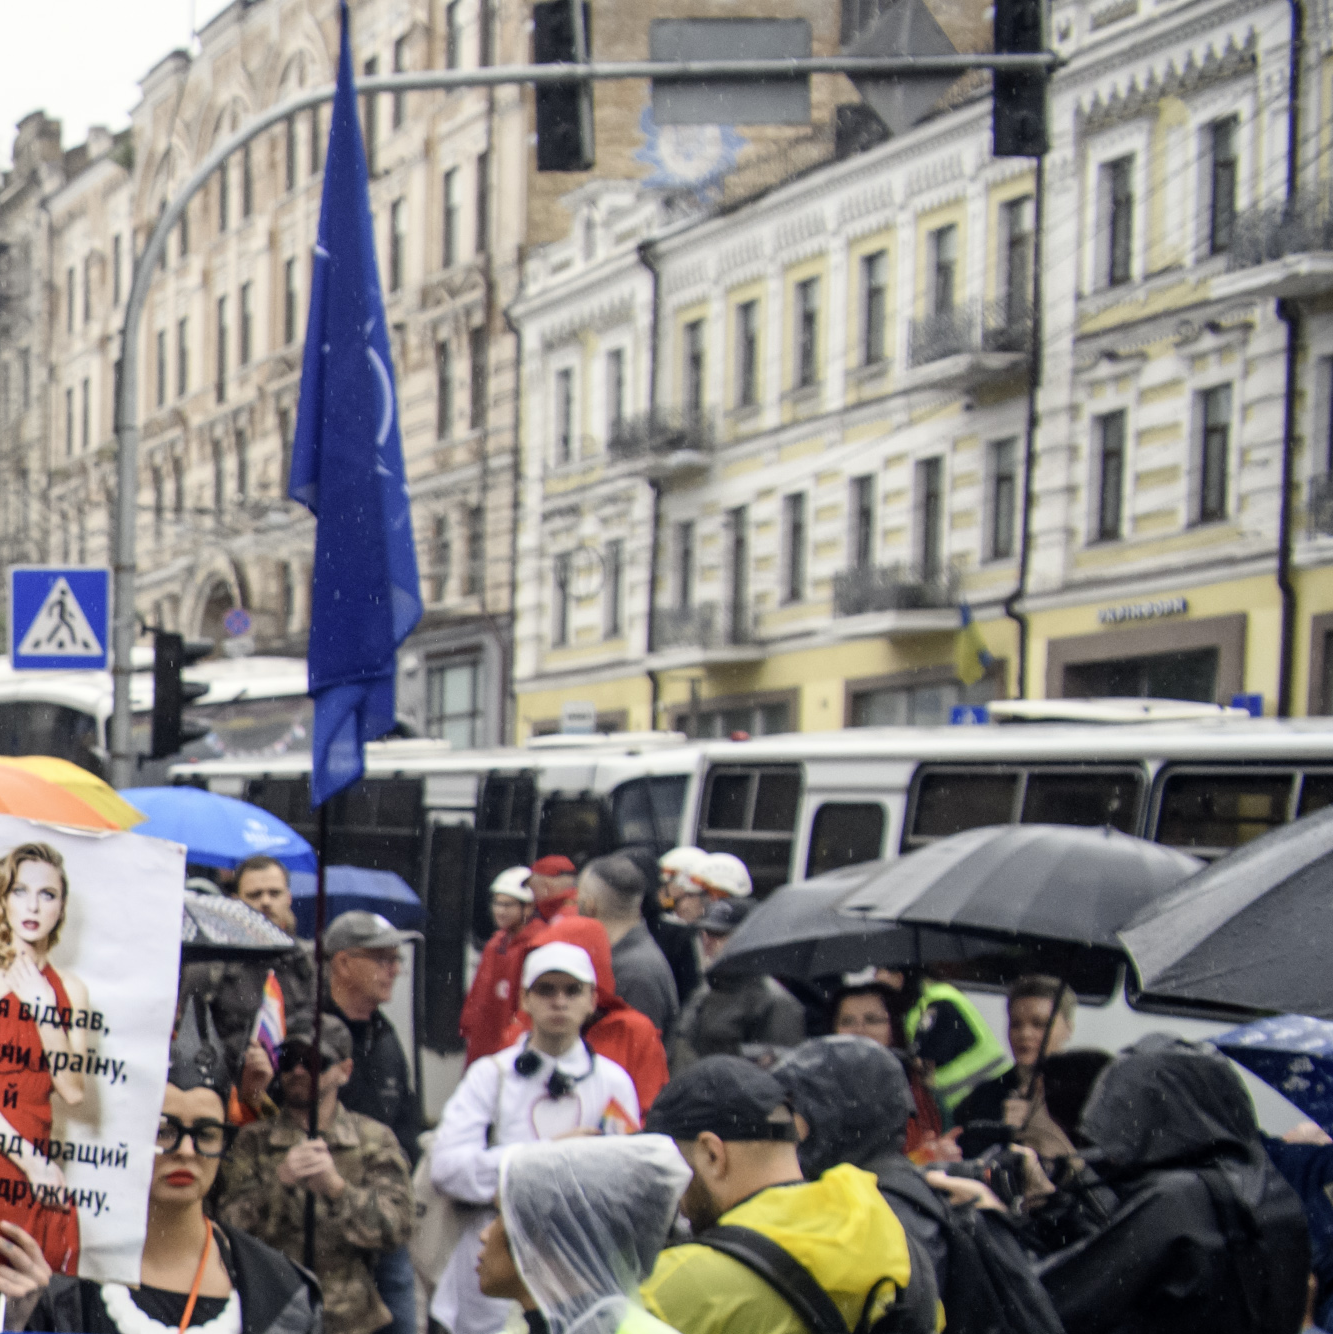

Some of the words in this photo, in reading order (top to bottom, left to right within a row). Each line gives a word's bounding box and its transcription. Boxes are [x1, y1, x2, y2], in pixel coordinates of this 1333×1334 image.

[18, 997, 111, 1036] віддав,
[40, 1049, 128, 1083] країну,
[2, 1083, 19, 1109] й
[32, 1137, 128, 1169] кращий
